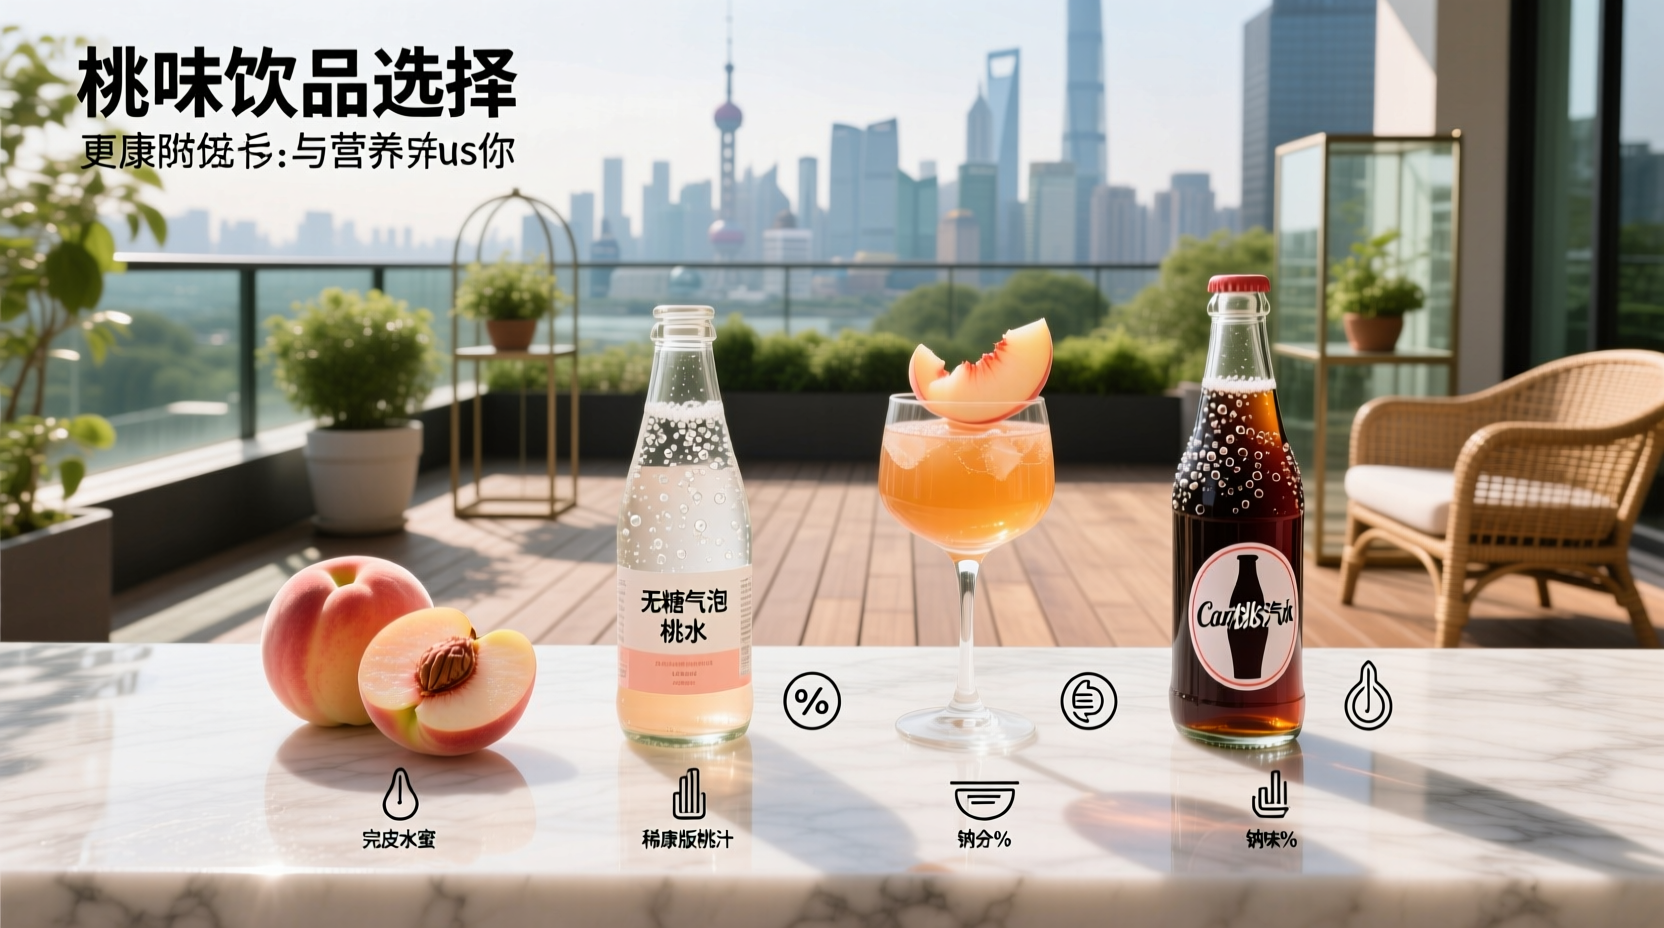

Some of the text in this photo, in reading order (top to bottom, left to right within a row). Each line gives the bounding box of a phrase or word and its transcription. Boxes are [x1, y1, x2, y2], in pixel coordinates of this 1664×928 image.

[641, 588, 728, 614] 无糖气泡
[660, 618, 707, 644] 桃水
